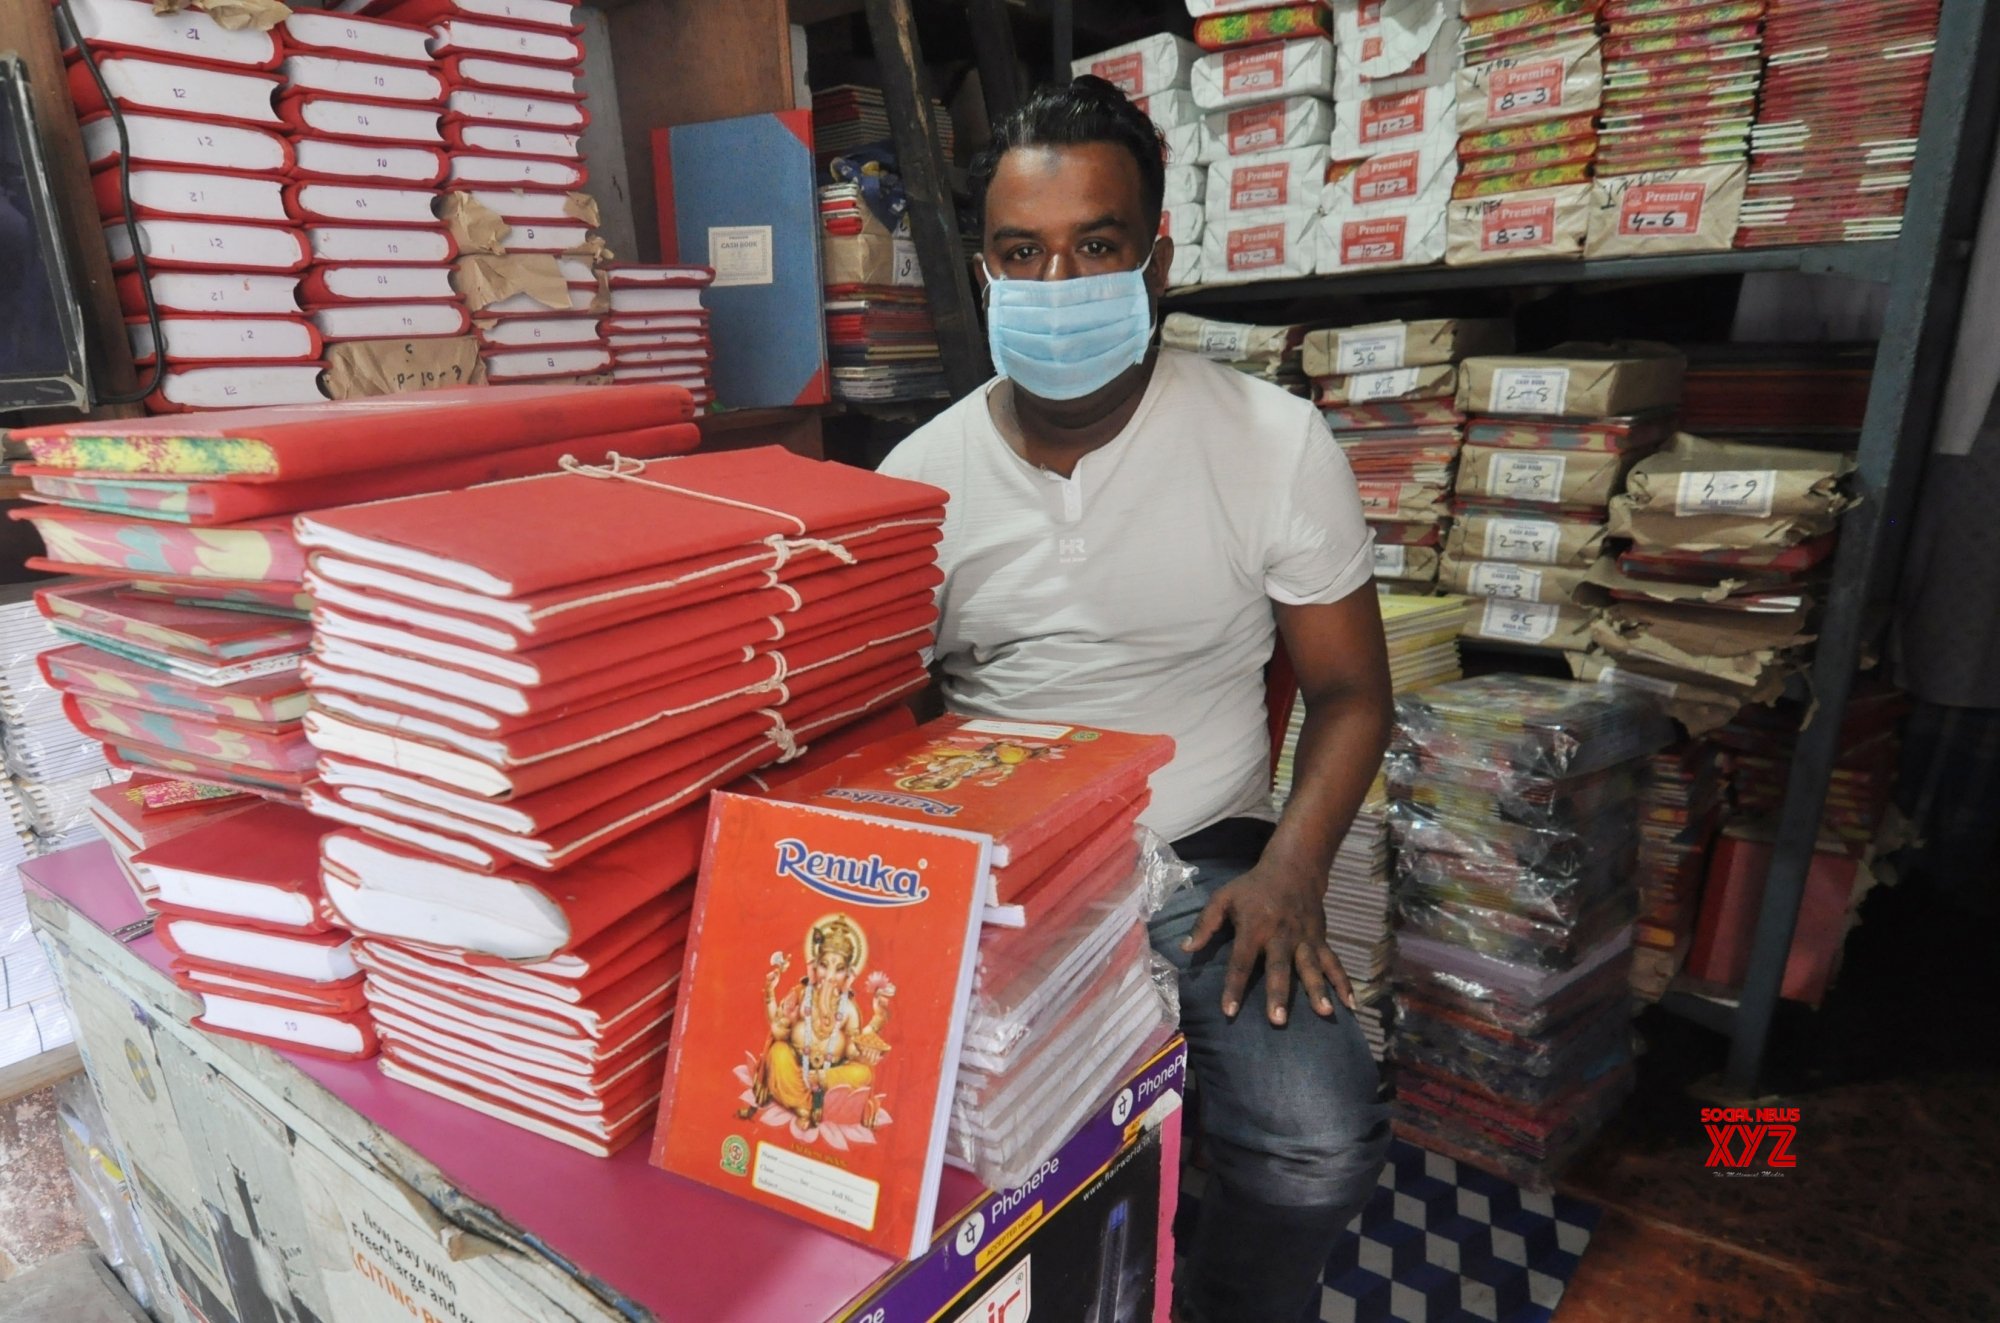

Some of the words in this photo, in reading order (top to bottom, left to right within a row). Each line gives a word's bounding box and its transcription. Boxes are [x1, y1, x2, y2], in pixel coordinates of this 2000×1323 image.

[374, 76, 384, 86] 10
[1508, 66, 1557, 84] Premier
[1377, 94, 1419, 110] Premier
[377, 158, 387, 167] 10
[1371, 157, 1413, 173] Premier
[1247, 168, 1283, 181] Premier
[1644, 190, 1697, 202] Premier
[1502, 205, 1548, 218] Premier
[1358, 221, 1400, 235] Premier
[1242, 230, 1280, 243] Premier
[825, 788, 963, 817] Renuka
[775, 838, 929, 907] Renuka
[991, 1157, 1060, 1224] PhonePe
[986, 1229, 1016, 1258] ACCEPTED
[1015, 1213, 1034, 1234] HERE
[363, 1210, 391, 1244] Now
[394, 1239, 420, 1268] pay
[424, 1259, 457, 1295] with
[352, 1222, 427, 1294] FreeCharge
[430, 1288, 456, 1317] and
[352, 1247, 417, 1316] CITING
